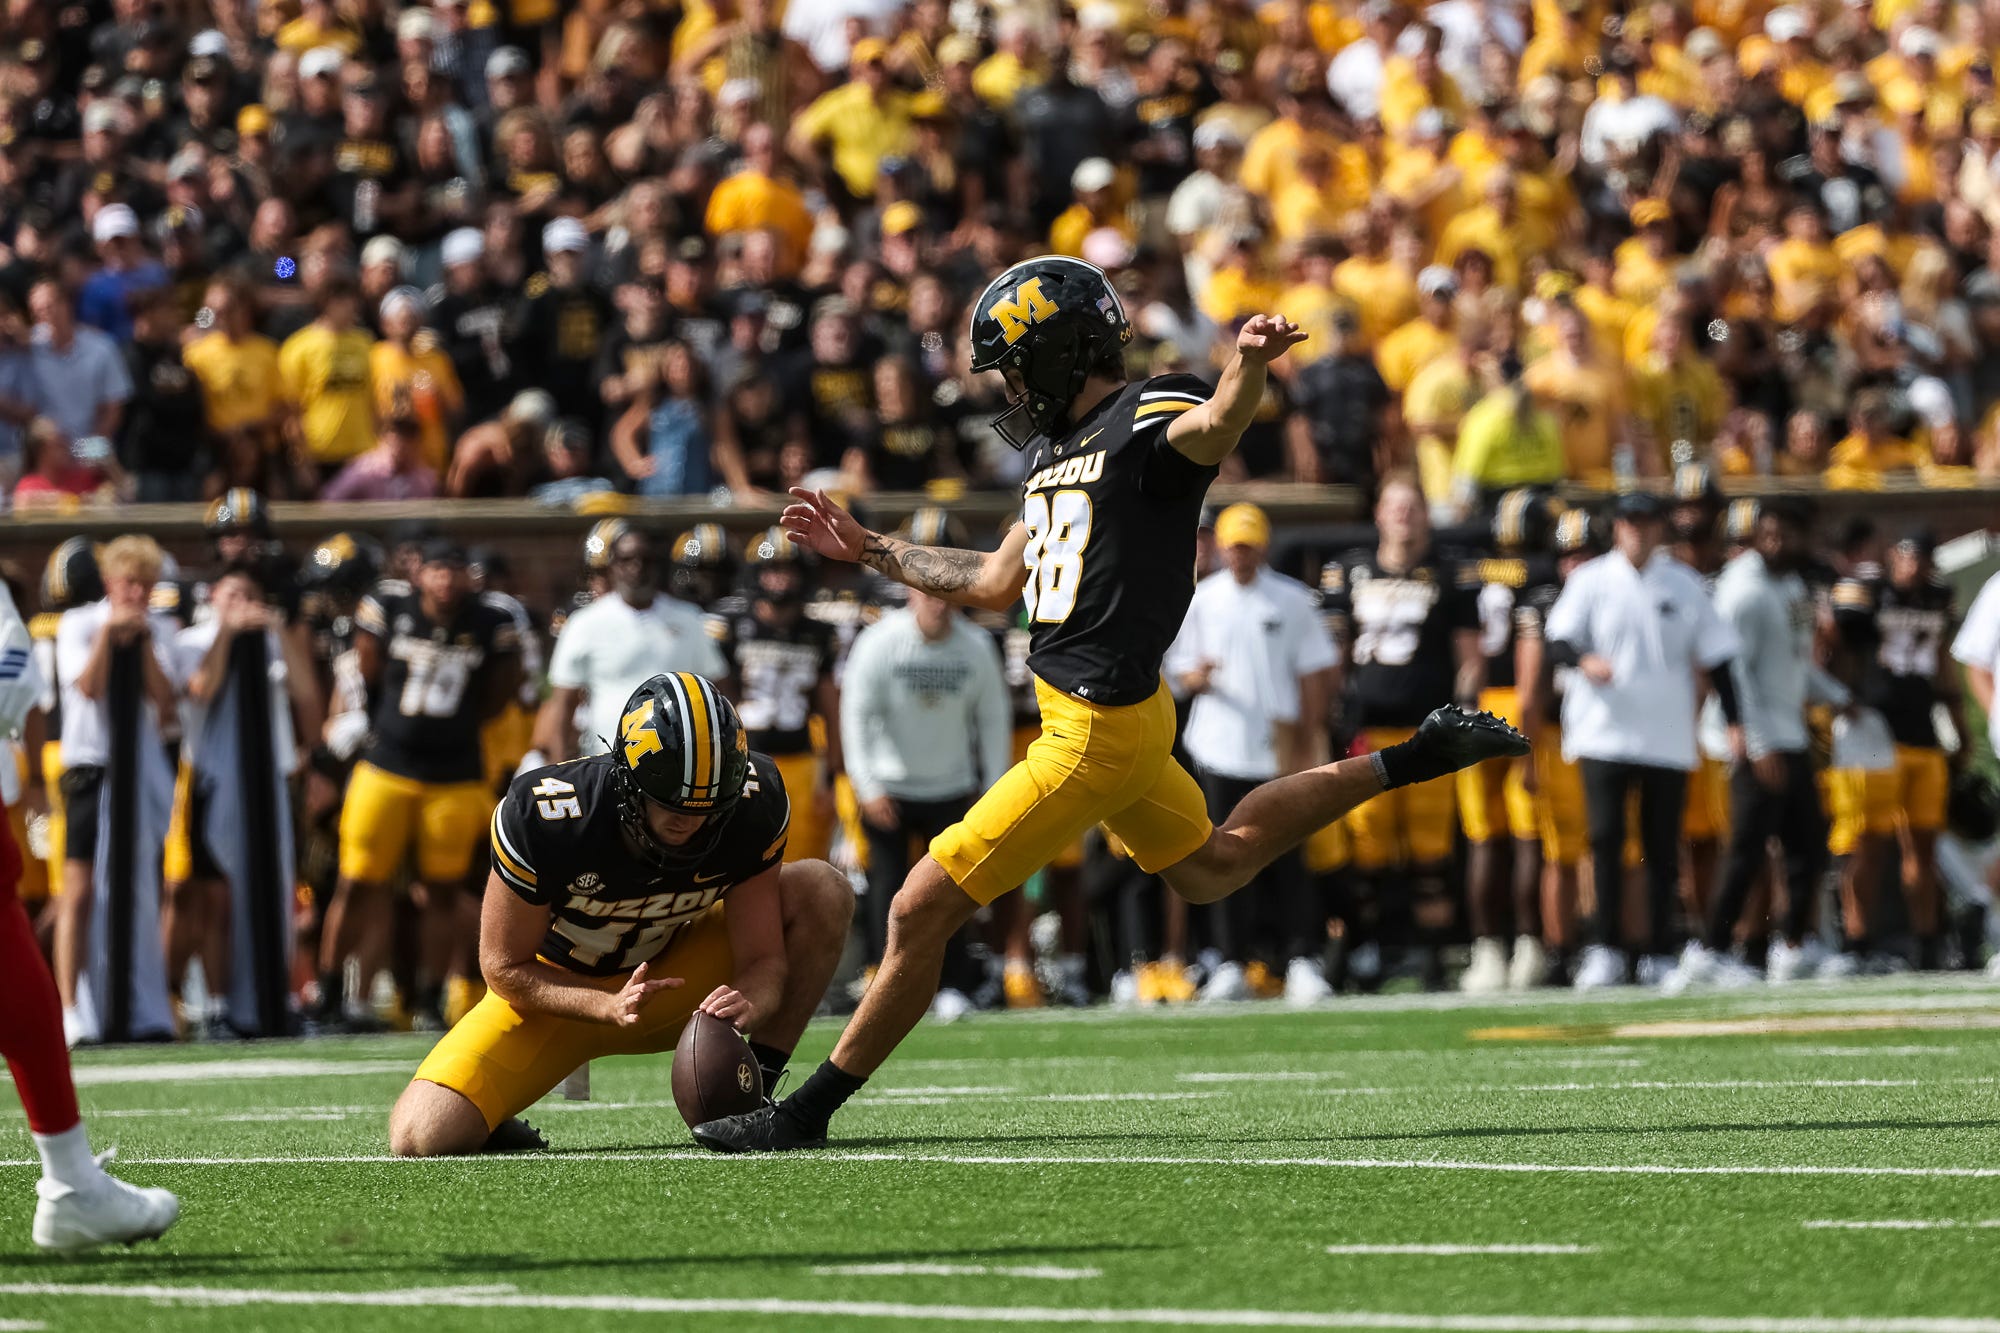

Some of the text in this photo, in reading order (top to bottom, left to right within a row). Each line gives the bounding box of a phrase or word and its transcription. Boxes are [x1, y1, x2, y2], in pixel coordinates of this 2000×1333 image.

[988, 276, 1060, 347] M
[1077, 685, 1089, 697] M
[532, 777, 583, 821] 45
[578, 874, 597, 887] SEC
